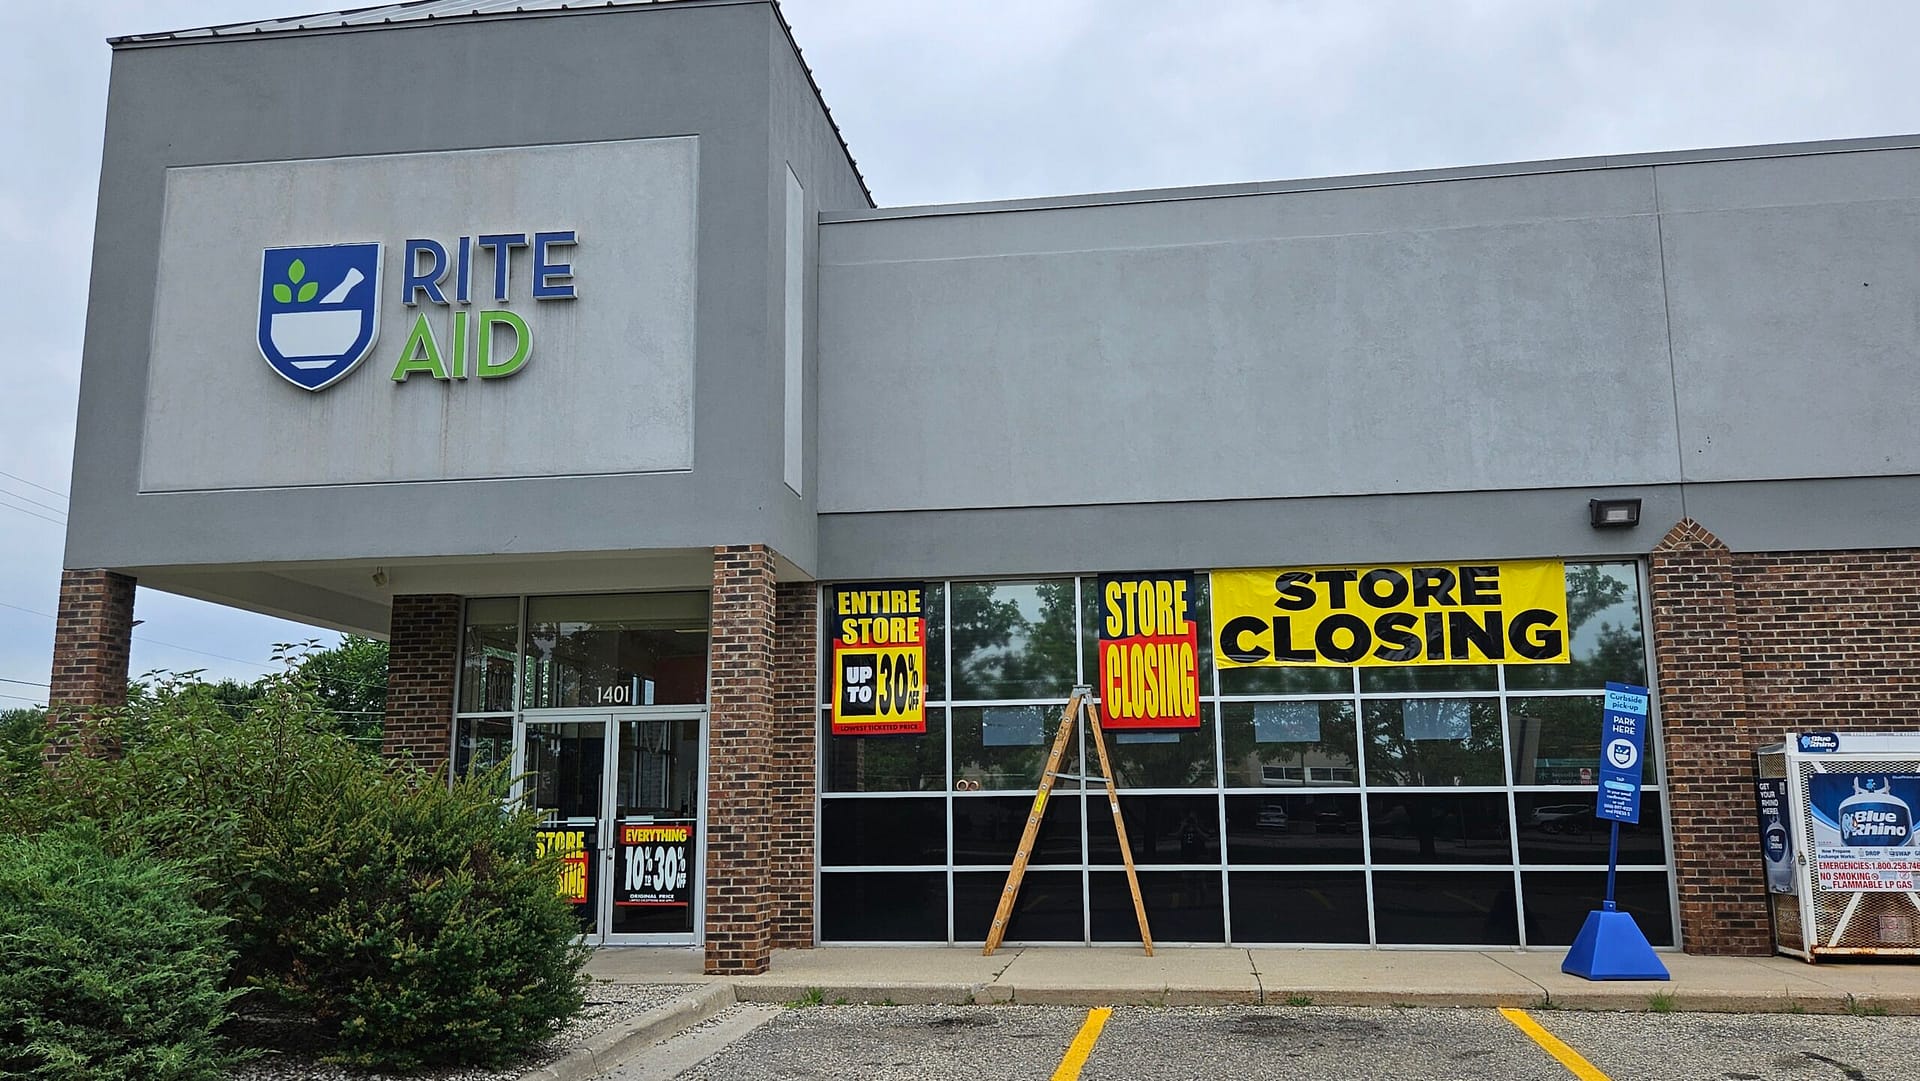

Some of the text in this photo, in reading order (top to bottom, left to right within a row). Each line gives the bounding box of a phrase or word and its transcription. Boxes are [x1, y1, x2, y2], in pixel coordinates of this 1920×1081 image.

[402, 231, 578, 307] RITE
[391, 310, 533, 382] AID
[1274, 566, 1502, 611] STORE
[838, 590, 921, 615] ENTIRE
[1105, 580, 1189, 637] STORE
[842, 617, 920, 645] STORE
[1219, 608, 1563, 664] CLOSING
[846, 666, 873, 684] UP
[1106, 642, 1196, 719] CLOSING
[597, 685, 629, 703] 1401
[847, 686, 872, 703] TO
[908, 690, 919, 711] OFF
[1610, 692, 1643, 704] Curbside
[1612, 702, 1639, 712] pick-up
[1612, 724, 1636, 735] HERE
[1613, 715, 1636, 727] PARK
[1854, 810, 1896, 823] Blue
[625, 828, 688, 842] EVERYTHING
[1852, 823, 1907, 836] Rhino
[536, 831, 585, 860] STORE
[676, 872, 687, 889] OFF
[1820, 872, 1870, 881] NO SMOKING
[1833, 880, 1884, 889] FLAMMABLE
